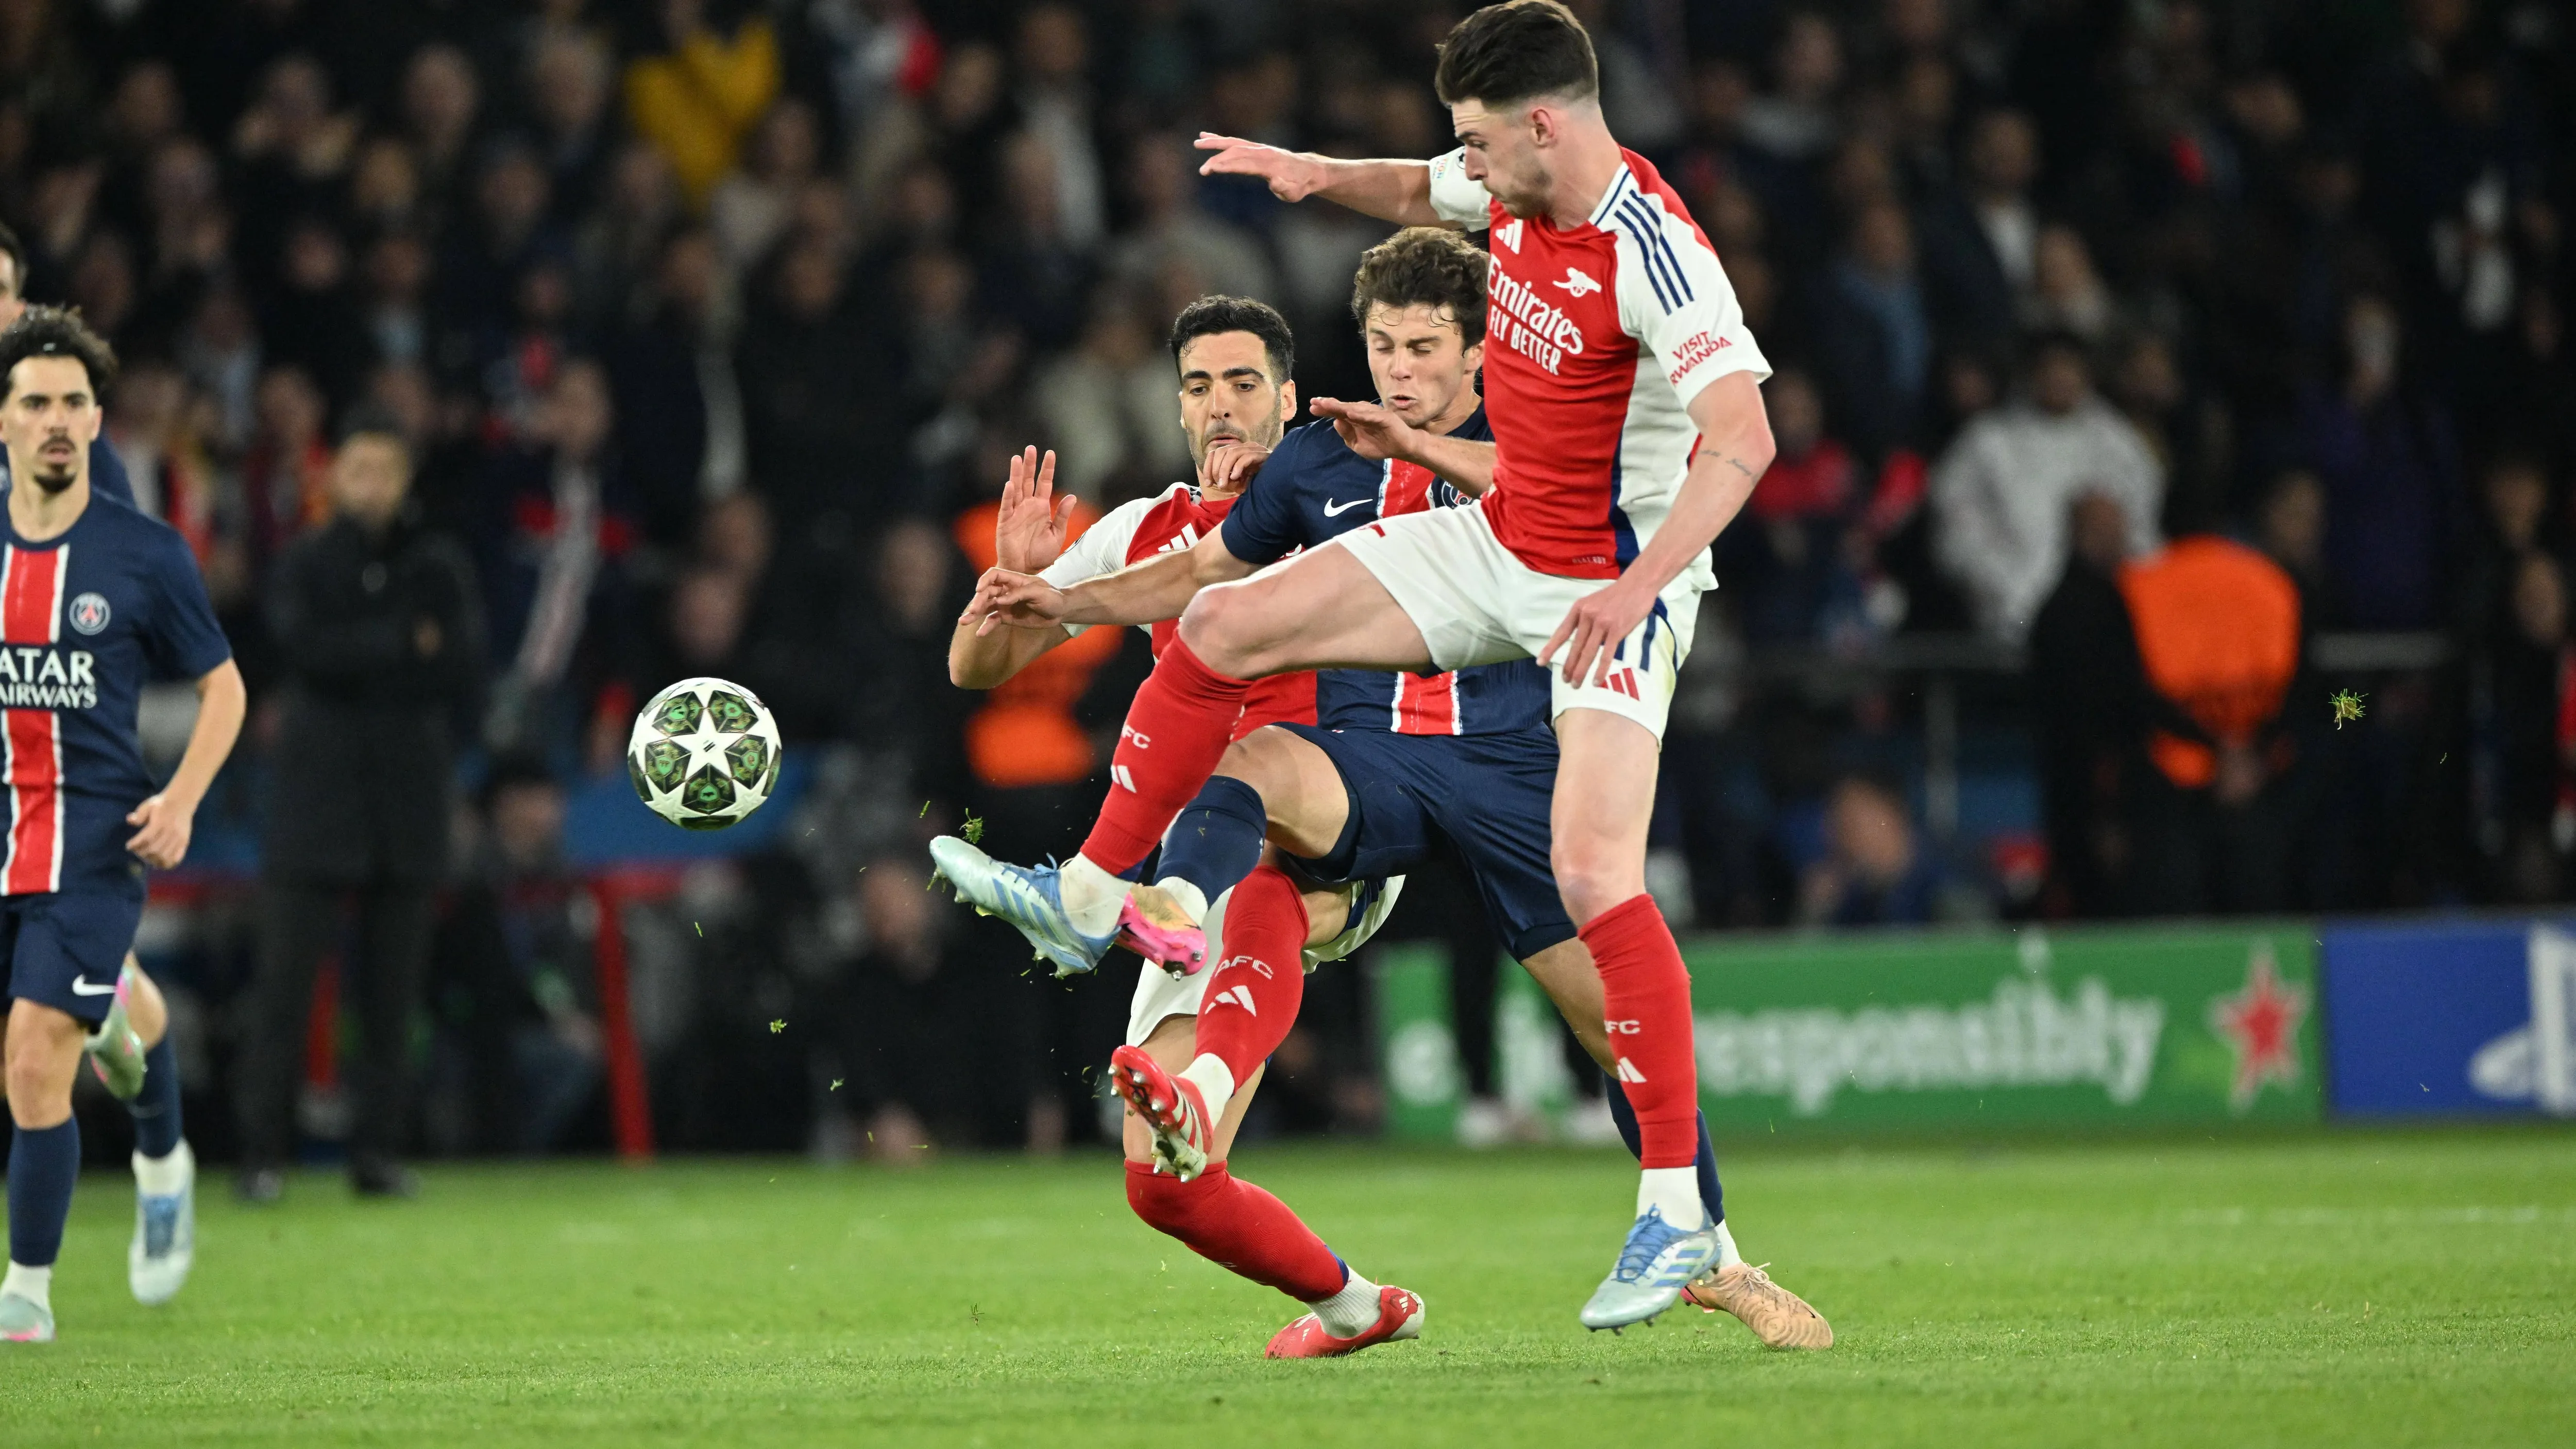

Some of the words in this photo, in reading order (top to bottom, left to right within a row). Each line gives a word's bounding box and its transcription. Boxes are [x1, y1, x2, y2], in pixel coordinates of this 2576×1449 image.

[1487, 253, 1583, 355] Emirates
[1489, 304, 1511, 342] FLY
[1510, 321, 1562, 376] BETTER
[1672, 331, 1709, 360] VISIT
[1669, 336, 1733, 387] RWANDA
[1121, 724, 1151, 749] FC
[1214, 956, 1274, 980] AFC
[1603, 1020, 1640, 1034] FC
